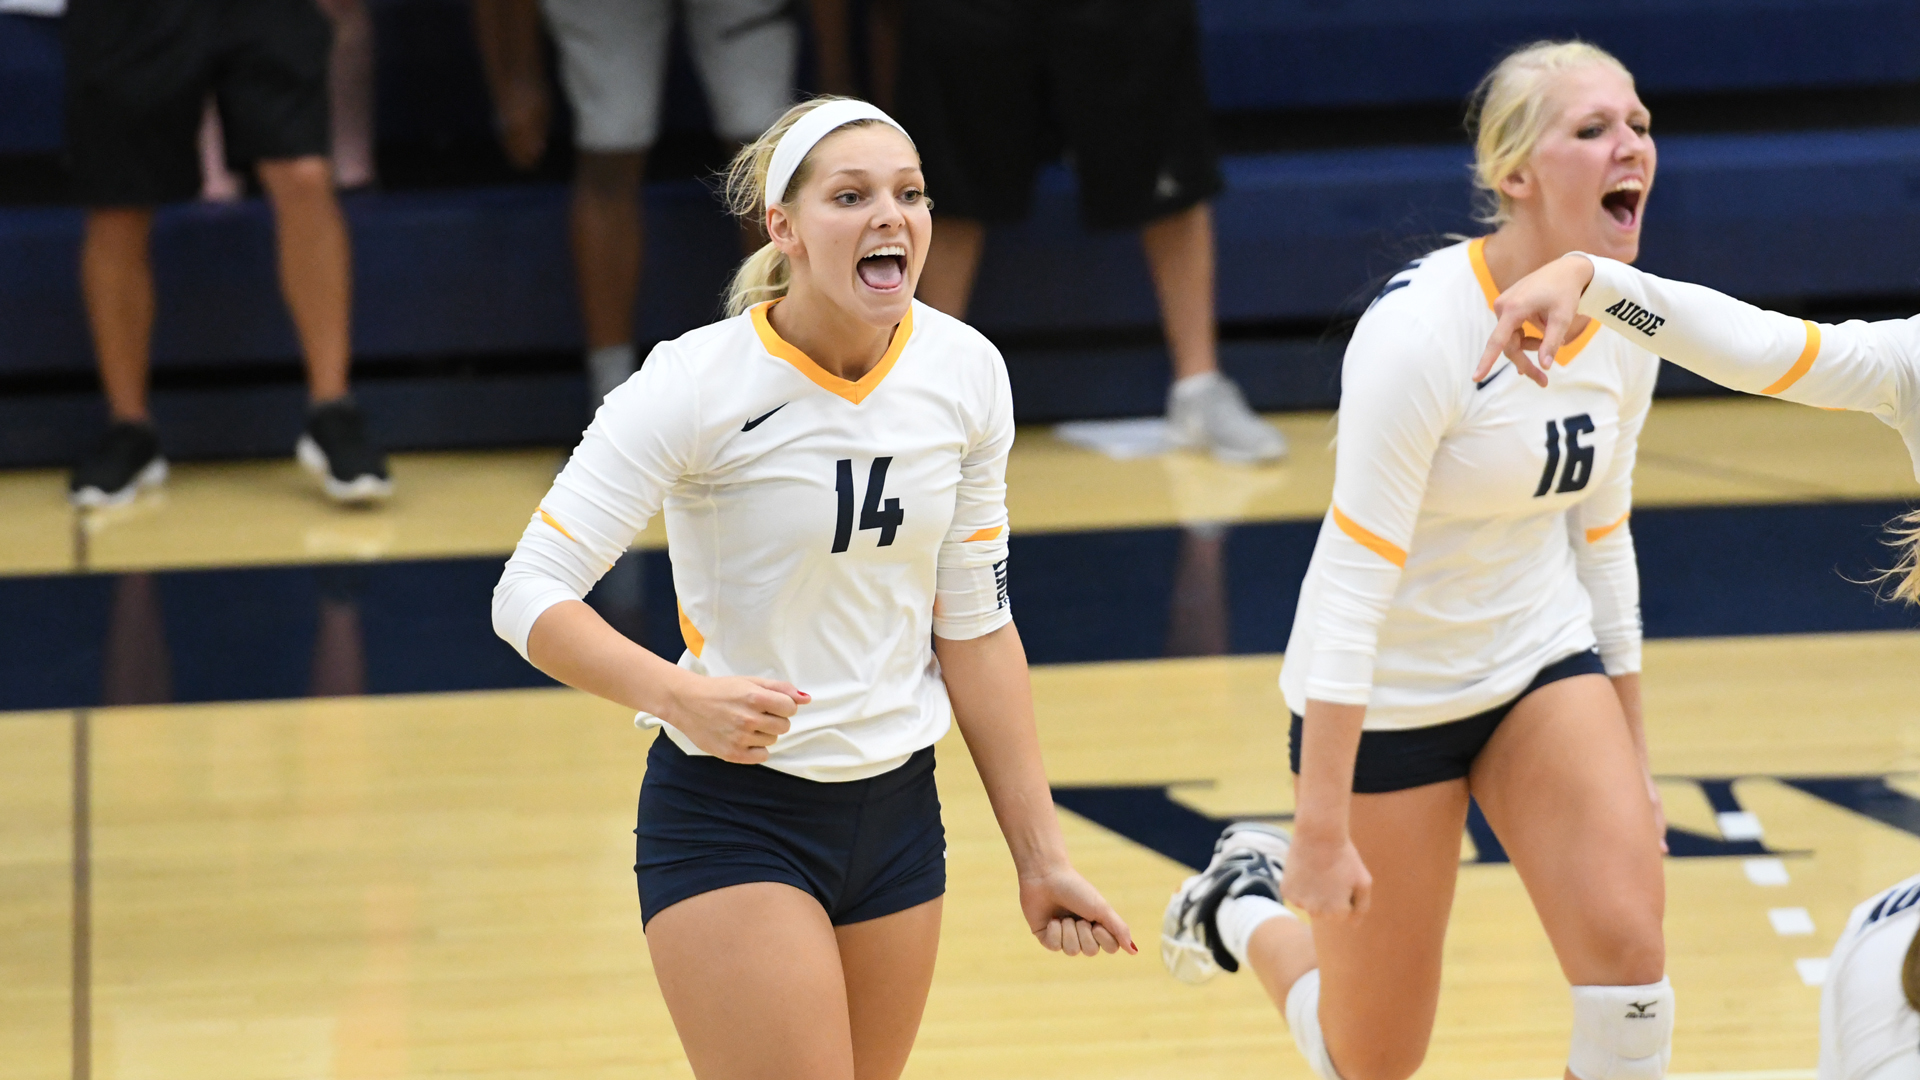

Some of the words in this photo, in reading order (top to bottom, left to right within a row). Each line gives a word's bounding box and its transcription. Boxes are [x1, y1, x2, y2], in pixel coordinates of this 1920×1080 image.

[1605, 298, 1666, 337] AUGIE
[1533, 412, 1595, 497] 16
[831, 456, 904, 554] 14
